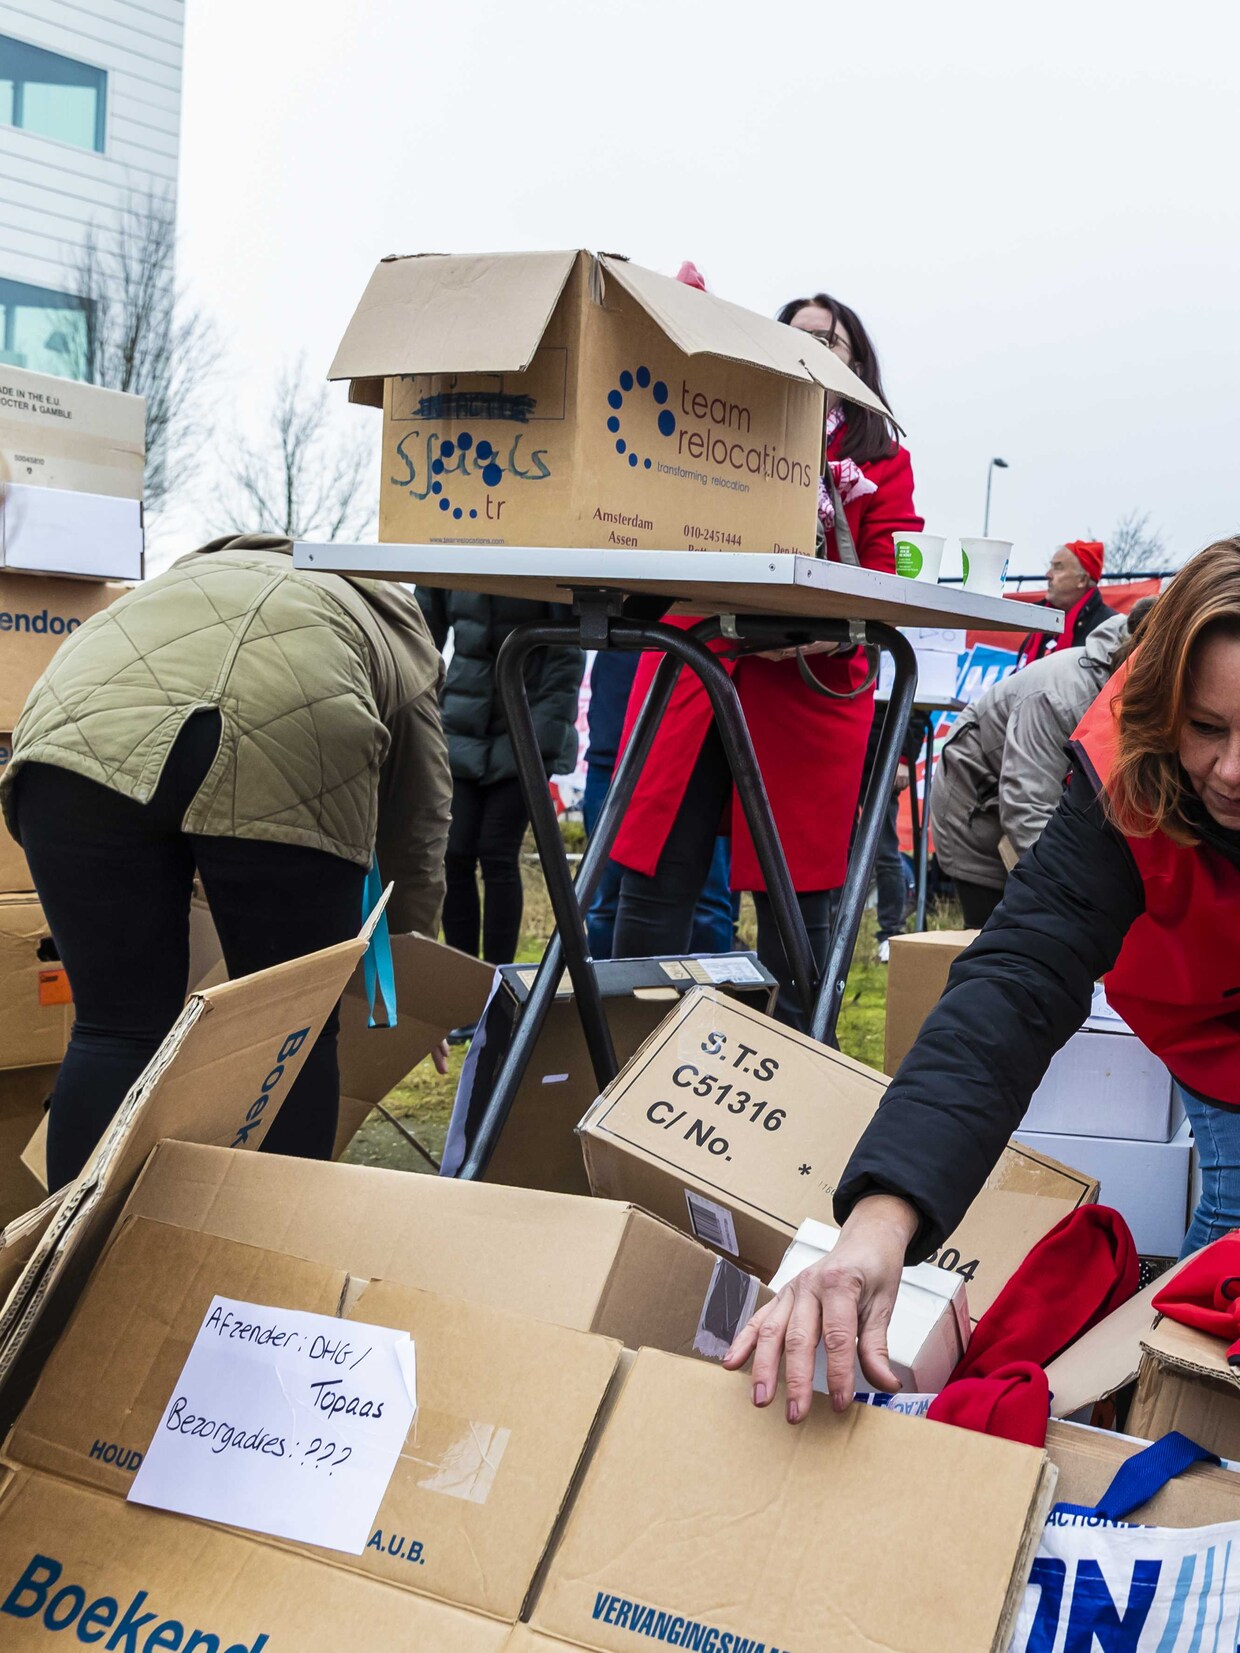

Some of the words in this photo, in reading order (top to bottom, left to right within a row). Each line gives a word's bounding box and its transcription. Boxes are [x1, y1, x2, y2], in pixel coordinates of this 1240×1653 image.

[0, 397, 29, 410] OCTER
[32, 404, 37, 412] &
[39, 405, 73, 419] GAMBLE
[16, 389, 25, 398] IN
[27, 391, 44, 403] THE
[681, 380, 750, 433] team
[678, 429, 812, 488] relocations
[657, 461, 708, 485] transforming
[711, 471, 750, 493] relocation
[486, 494, 506, 519] tr
[593, 507, 653, 530] Amsterdam
[608, 531, 638, 547] Assen
[683, 525, 742, 547] 010-2451444
[0, 609, 82, 635] endoo
[672, 1064, 787, 1131] C51316
[683, 1118, 732, 1162] No.
[311, 1380, 384, 1419] Topaas
[89, 1439, 143, 1471] HOUD
[366, 1529, 425, 1565] A.U.B.
